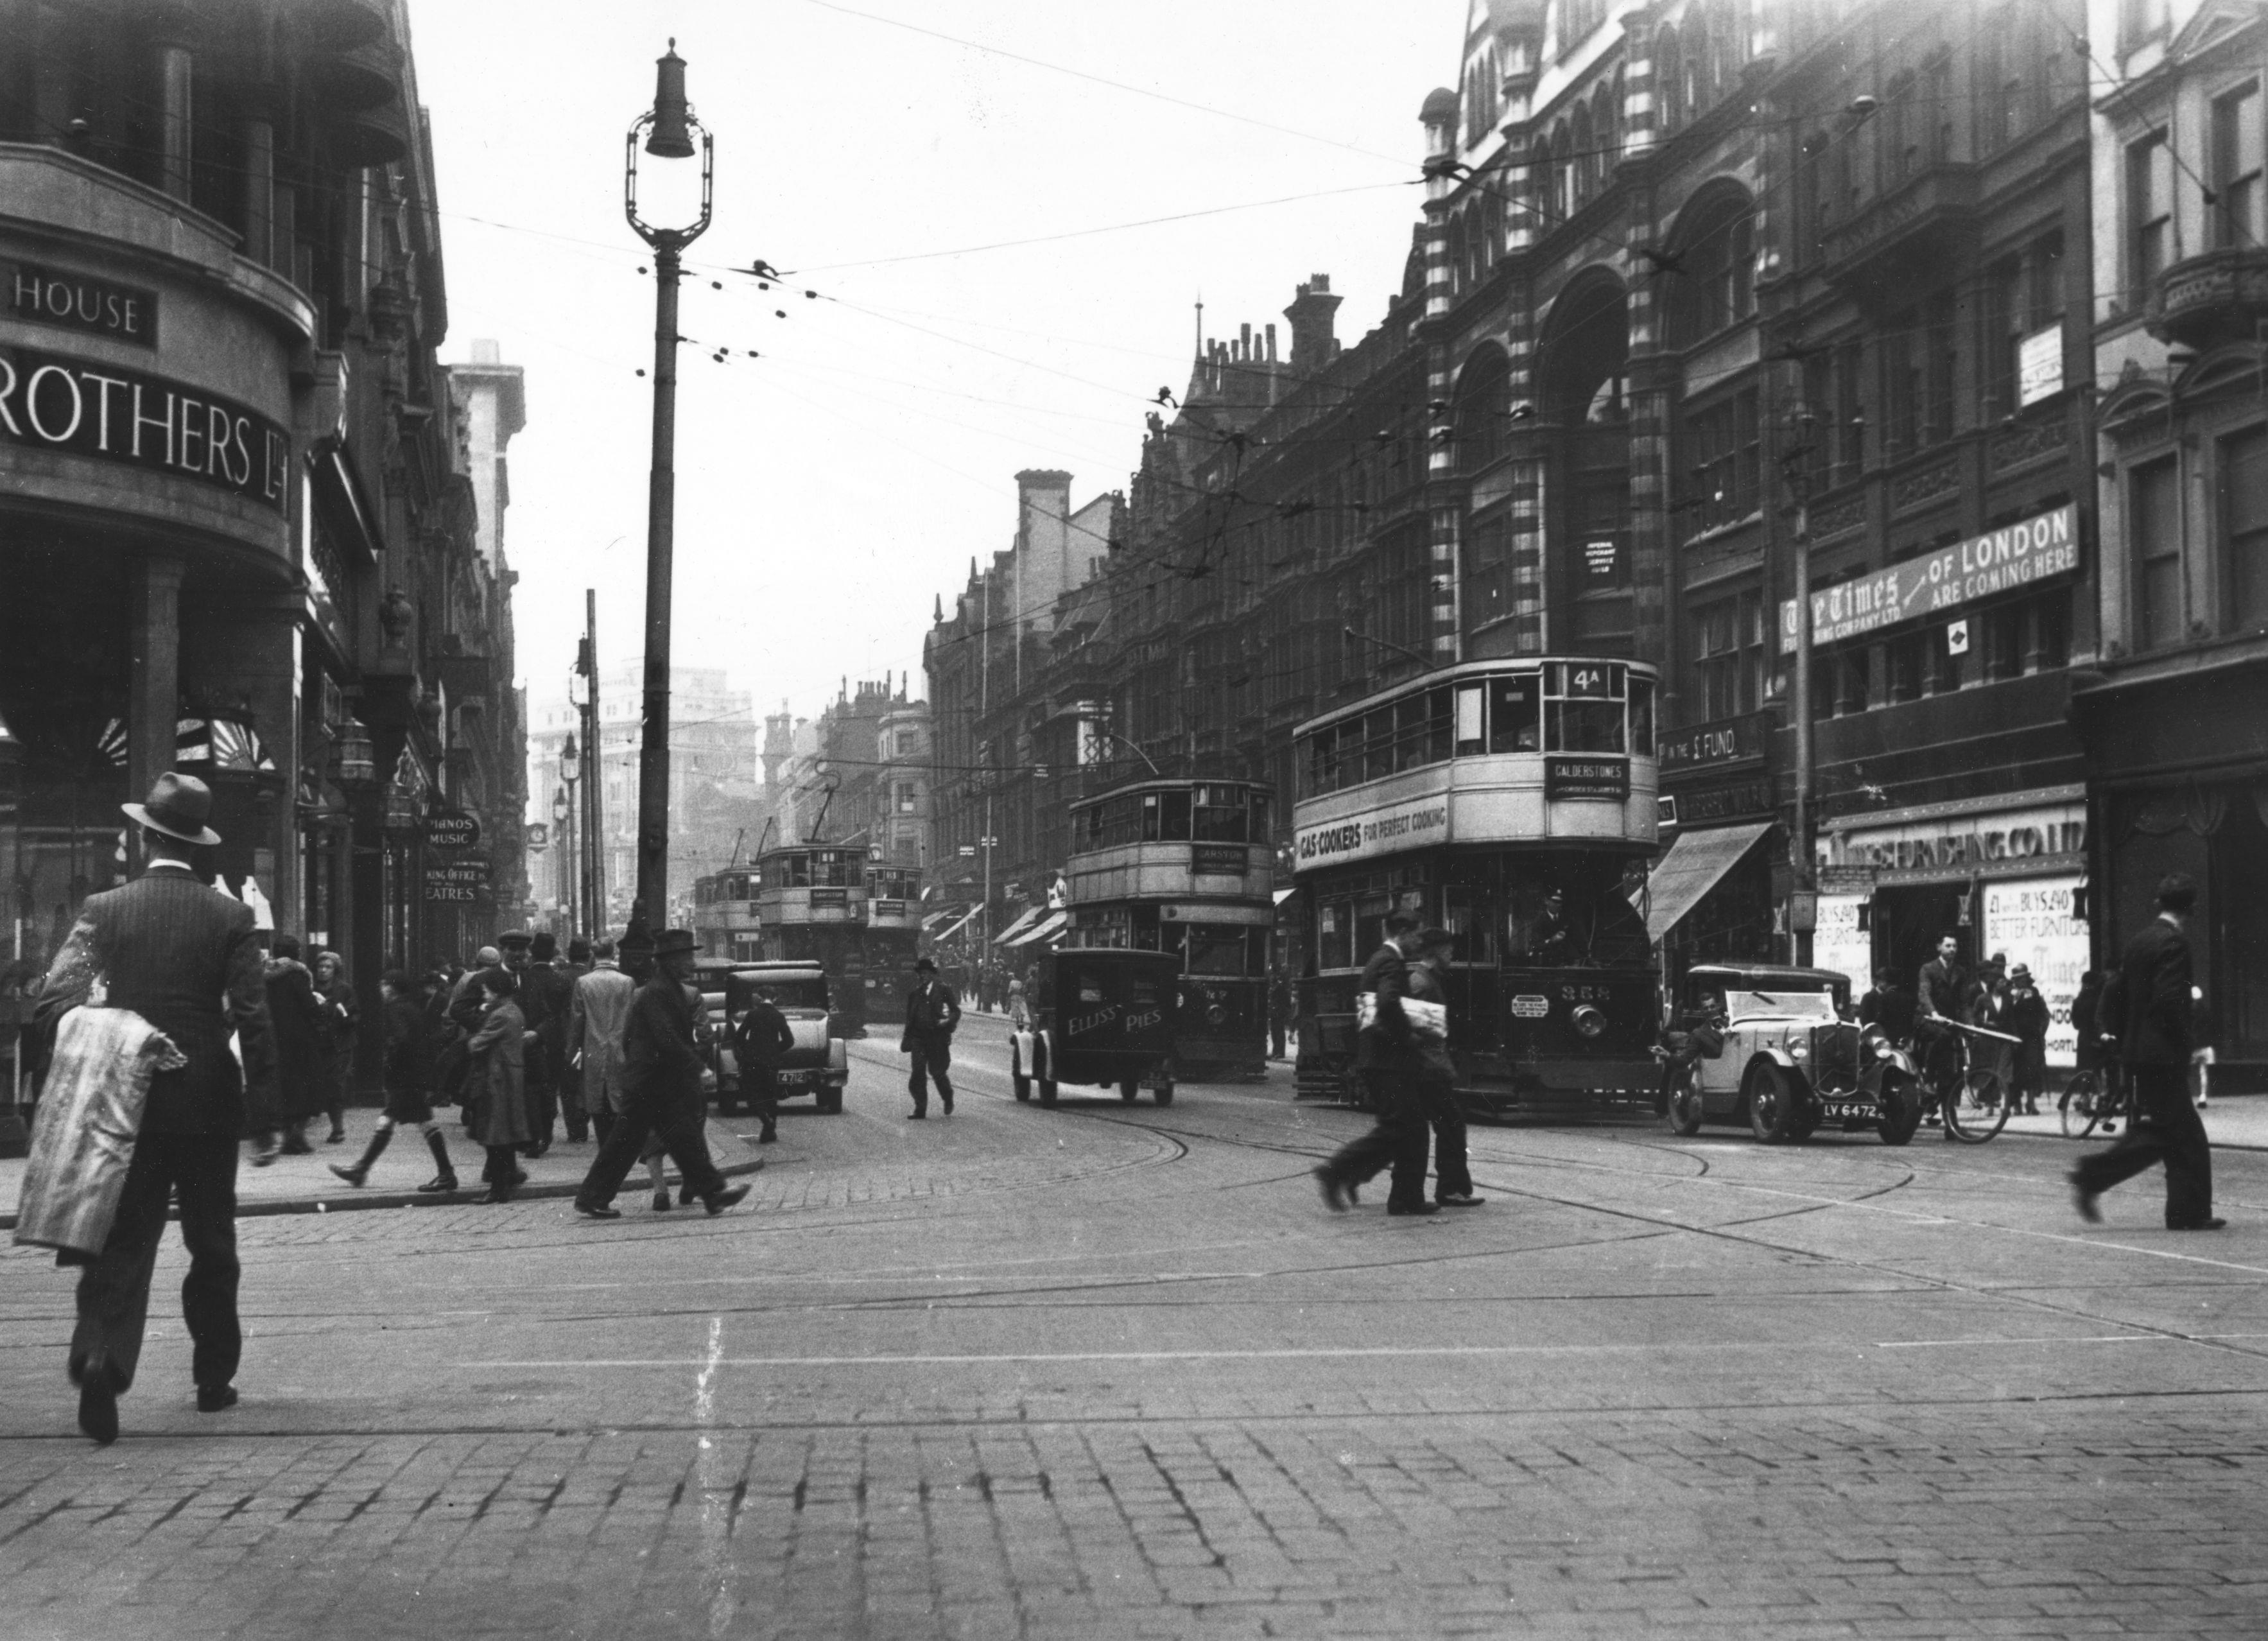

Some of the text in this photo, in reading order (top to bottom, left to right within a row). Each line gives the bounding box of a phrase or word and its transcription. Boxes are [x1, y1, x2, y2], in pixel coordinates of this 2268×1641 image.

[16, 274, 137, 333] HOUSE
[0, 357, 250, 485] ROTHERS
[1929, 509, 2068, 584] OF LONDON
[1931, 544, 2075, 611] ARE COMING HERE
[1786, 571, 1898, 635] Te Times
[1835, 612, 1880, 638] COMPANY
[1574, 670, 1599, 690] 4A
[1555, 764, 1622, 778] CALDERSTONES
[1364, 822, 1377, 842] FOR
[1379, 815, 1410, 838] PERFECT
[1412, 807, 1445, 831] COOKING
[429, 834, 469, 844] MUSIC
[448, 868, 476, 881] OFFICE
[426, 888, 474, 899] EATRES
[1126, 1009, 1161, 1032] PIES
[1824, 1105, 1876, 1117] LV 6472
